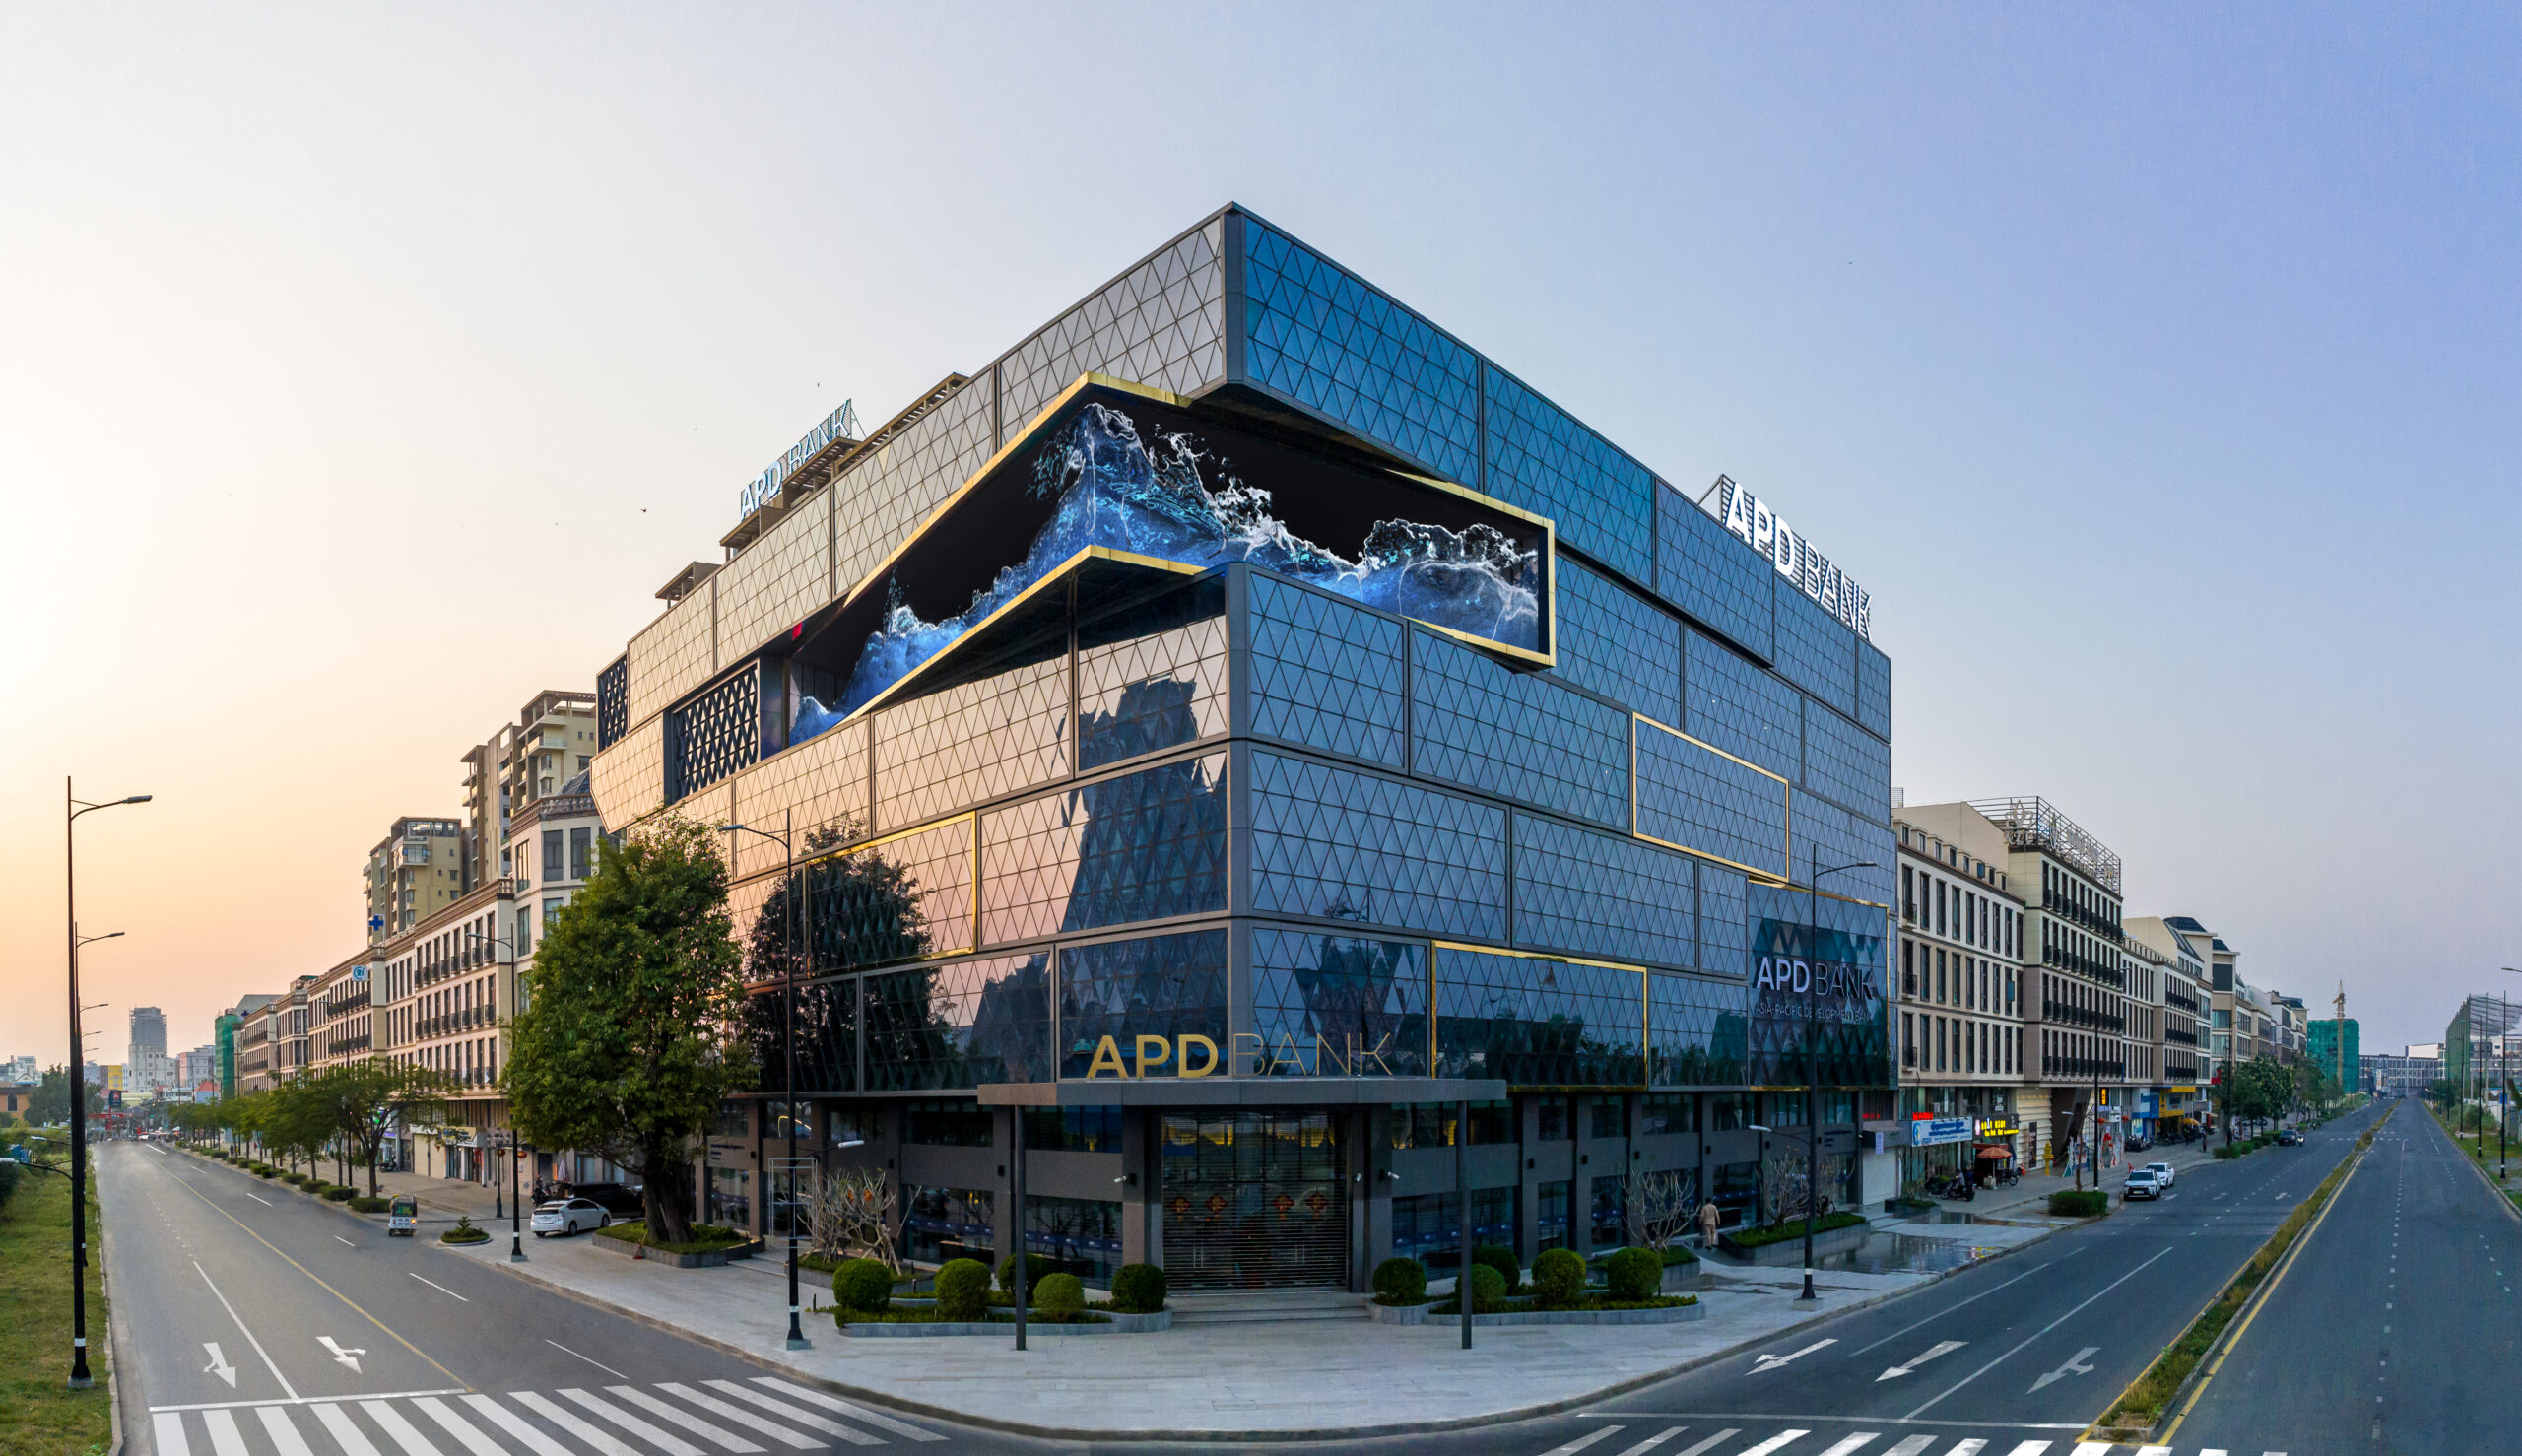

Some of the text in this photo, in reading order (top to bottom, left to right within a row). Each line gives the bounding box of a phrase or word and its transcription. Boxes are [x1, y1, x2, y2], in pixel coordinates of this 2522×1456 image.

[741, 399, 850, 522] APD BANK
[1725, 482, 1872, 642] APD BANK
[1756, 956, 1873, 1000] APD BANK
[1755, 1002, 1803, 1018] ASIA-PACIFIC
[1087, 1032, 1393, 1079] APD BANK
